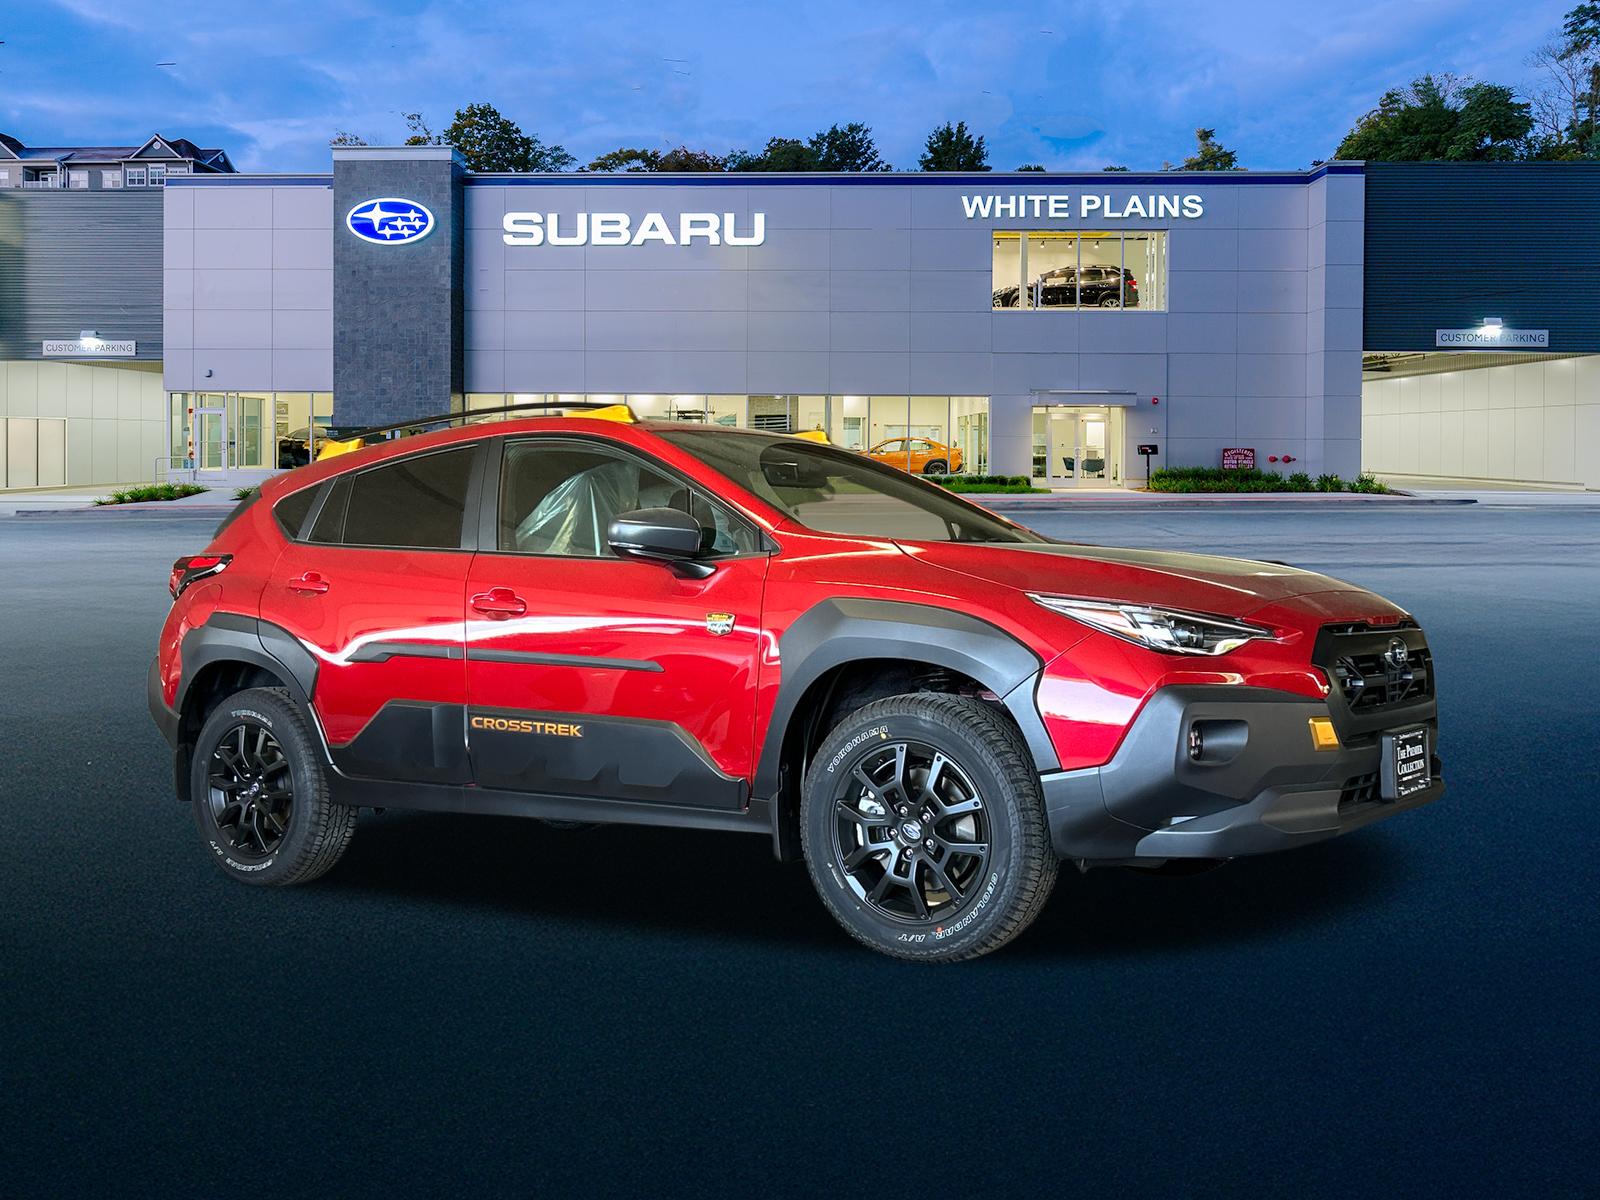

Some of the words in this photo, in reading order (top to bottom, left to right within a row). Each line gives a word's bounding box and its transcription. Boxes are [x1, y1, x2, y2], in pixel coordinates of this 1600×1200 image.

[961, 195, 1069, 218] WHITE
[1081, 195, 1204, 218] PLAINS
[502, 212, 766, 246] SUBARU
[46, 344, 92, 352] CUSTOMER
[95, 344, 133, 352] PARKING
[1440, 333, 1496, 342] CUSTOMER
[1498, 334, 1545, 342] PARKING
[471, 716, 583, 737] CROSSTREK
[827, 725, 888, 773] YOKOHAMA
[935, 872, 999, 939] GEOLANDAR
[898, 934, 926, 942] A/T
